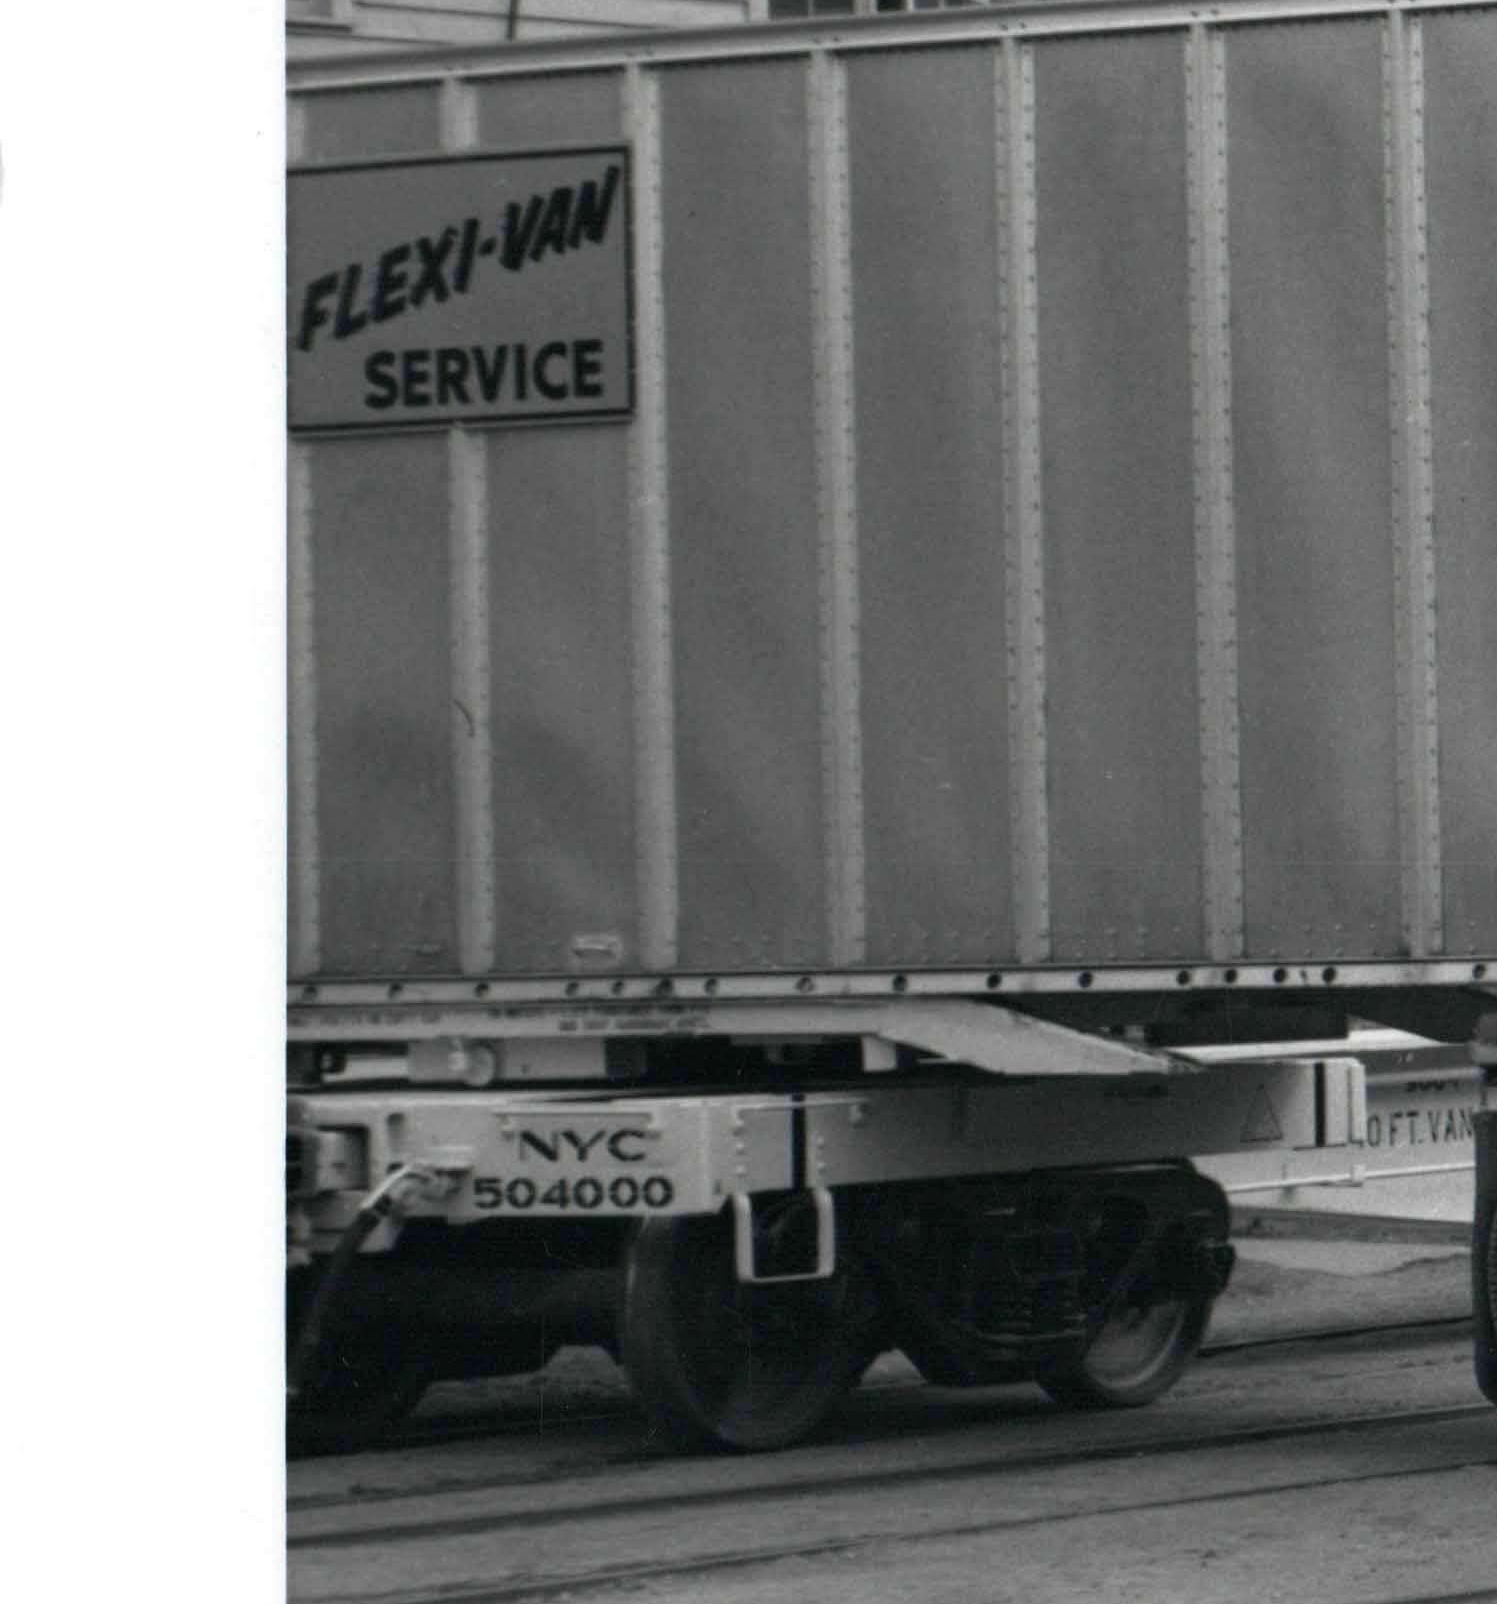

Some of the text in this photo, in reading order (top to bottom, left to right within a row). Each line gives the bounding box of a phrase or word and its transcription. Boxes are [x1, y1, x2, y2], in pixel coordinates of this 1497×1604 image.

[297, 165, 620, 352] FLEXI-VAN
[364, 339, 604, 410] SERVICE
[518, 1129, 648, 1163] NYC
[473, 1176, 674, 1209] 504000
